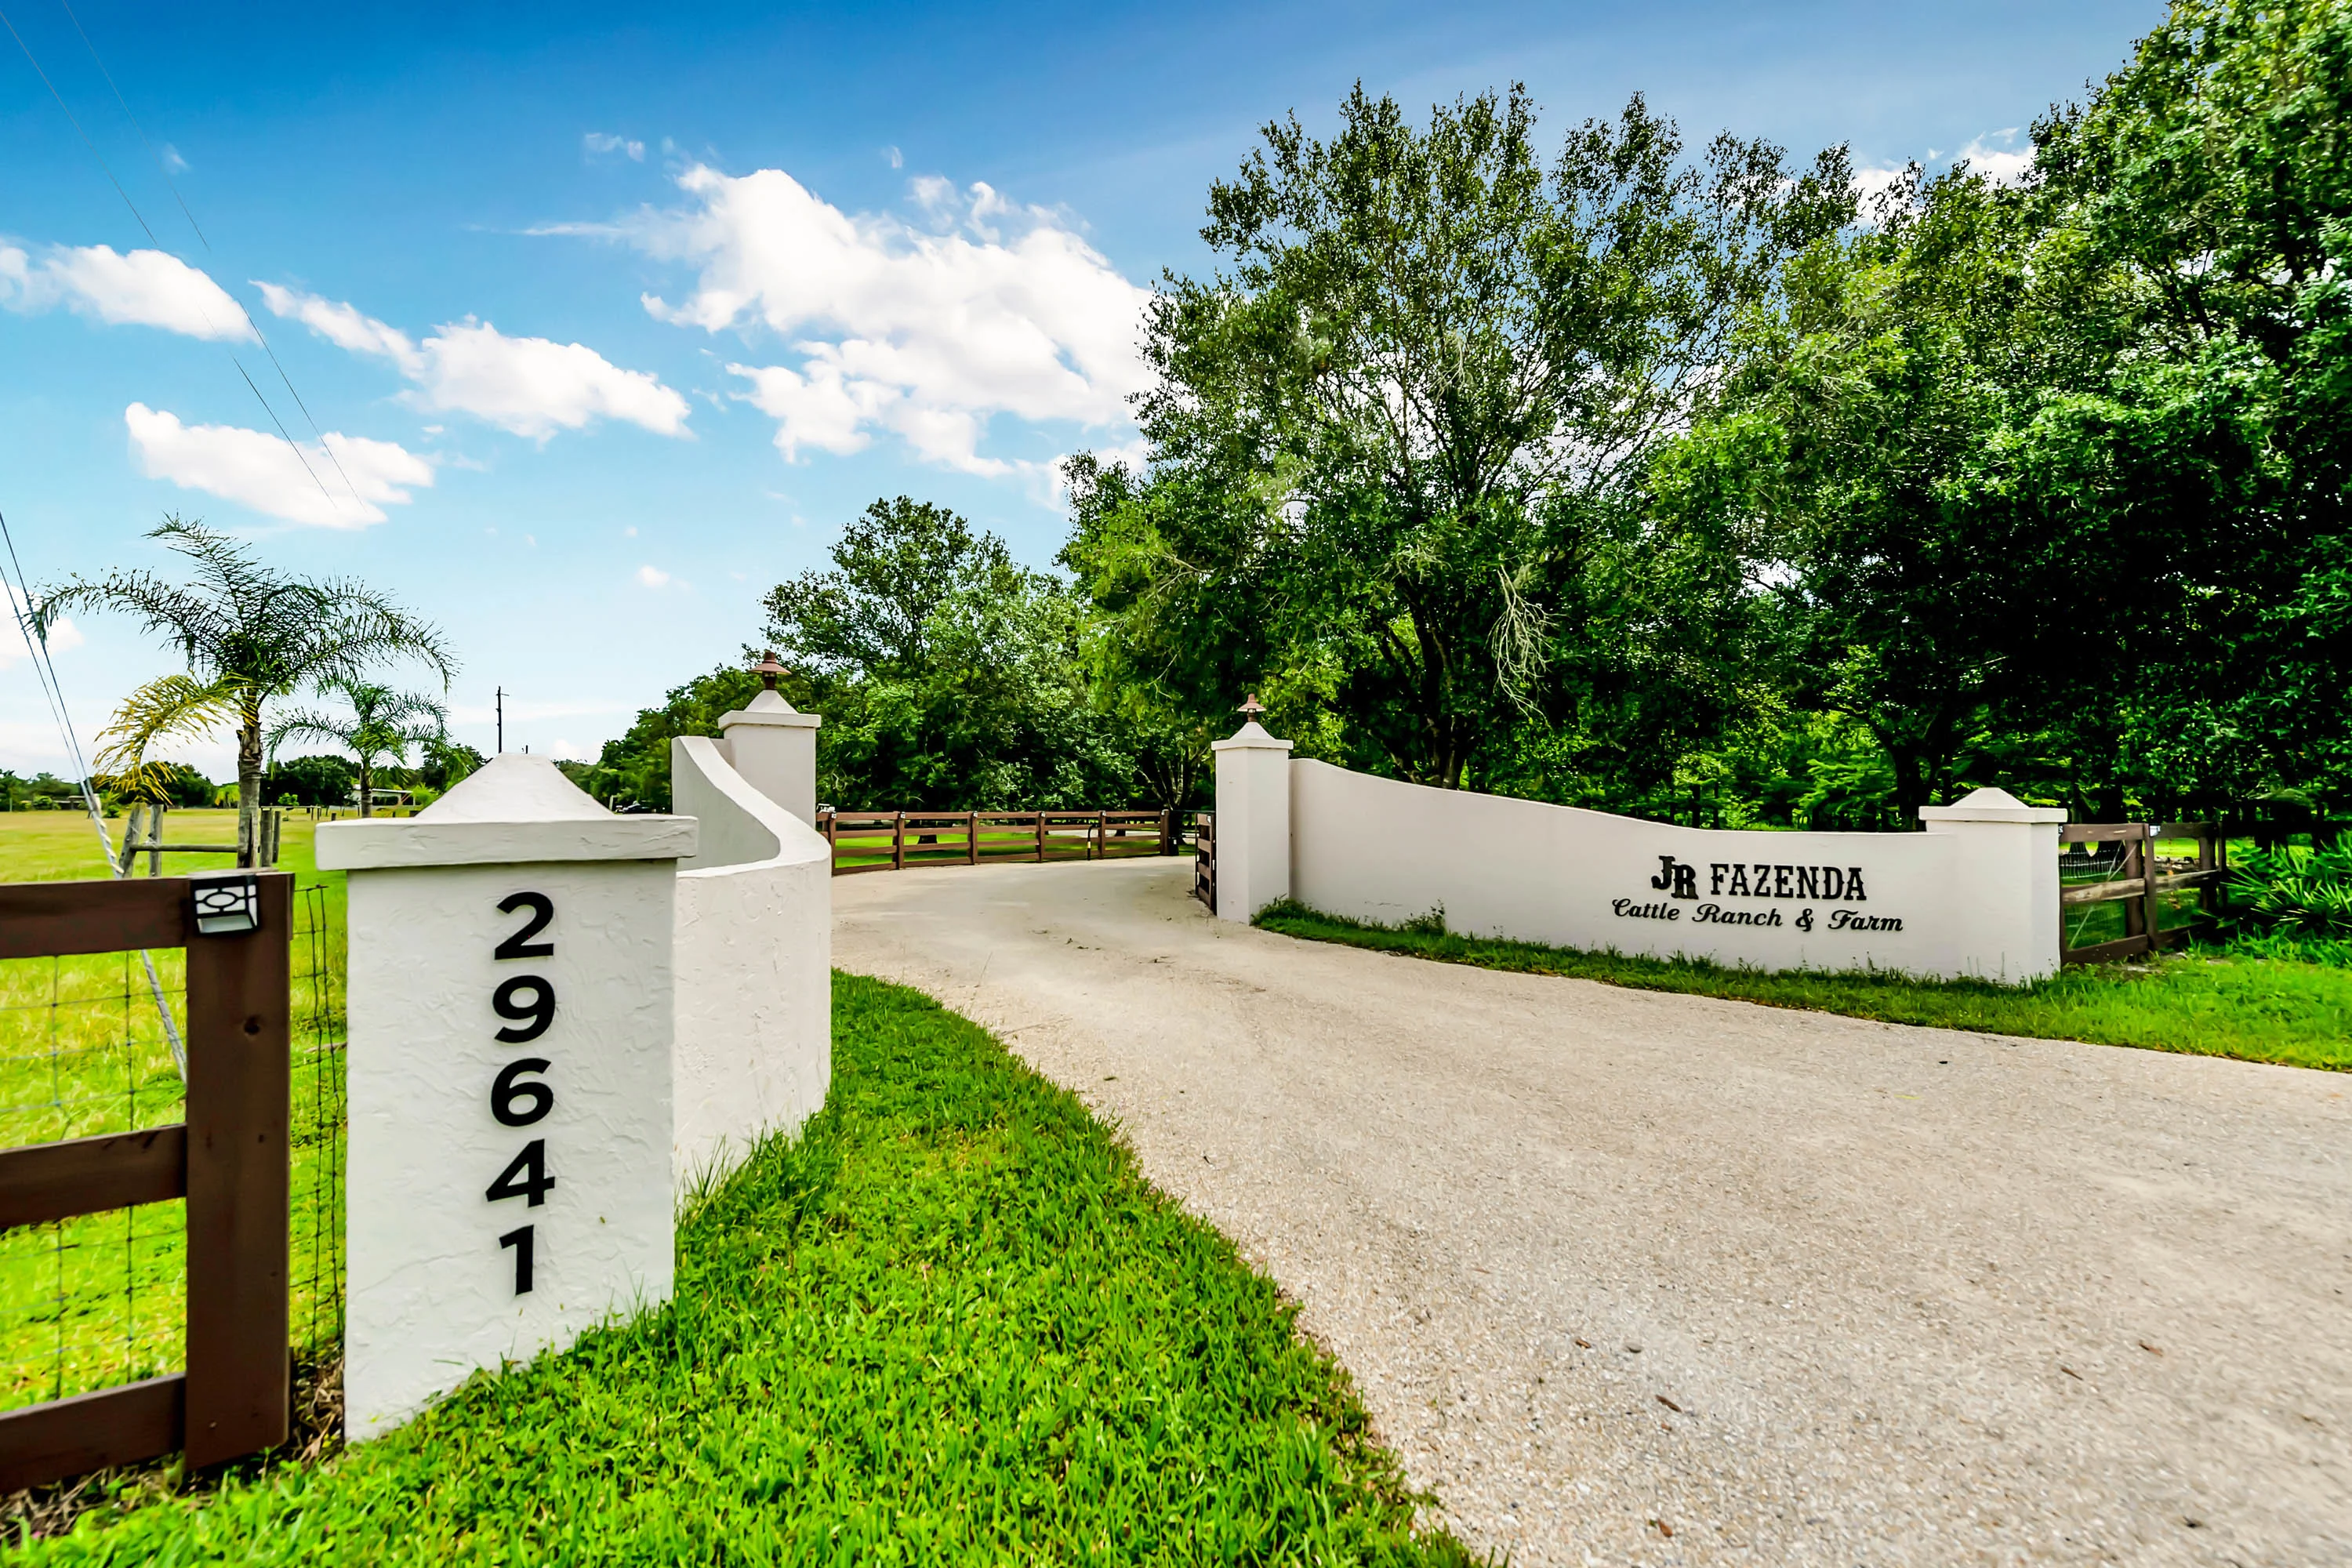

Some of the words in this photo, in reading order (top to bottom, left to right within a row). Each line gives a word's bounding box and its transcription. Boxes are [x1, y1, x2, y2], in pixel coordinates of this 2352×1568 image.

[1650, 855, 1700, 900] JR
[1710, 862, 1867, 902] FAZENDA
[1611, 898, 1681, 921] Cattle
[1691, 902, 1783, 927] Ranch
[1795, 908, 1815, 932] &
[1827, 909, 1904, 932] Farm
[485, 891, 556, 1297] 29641
